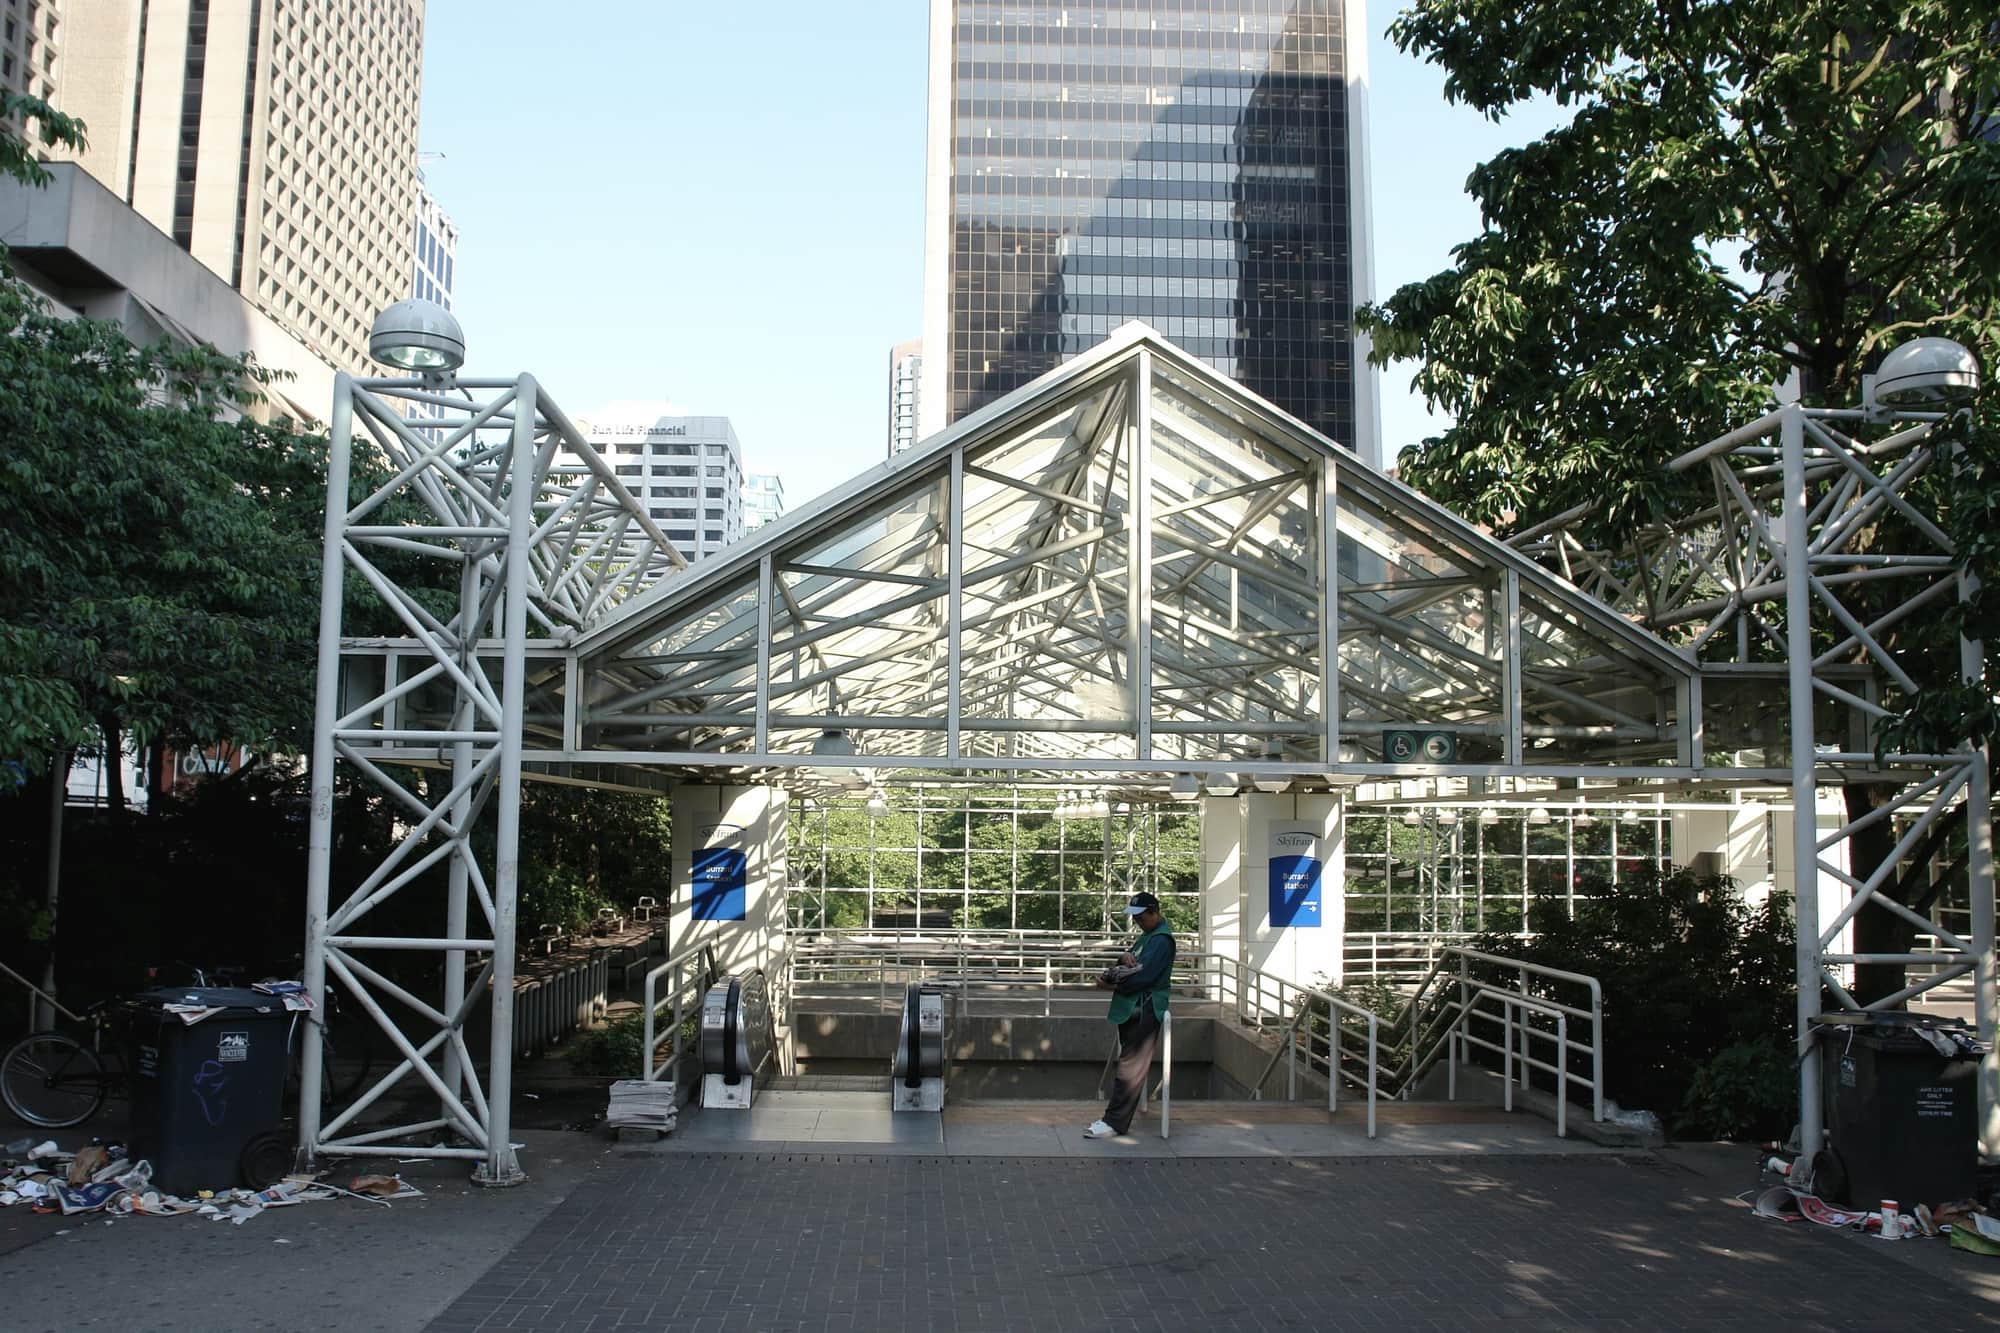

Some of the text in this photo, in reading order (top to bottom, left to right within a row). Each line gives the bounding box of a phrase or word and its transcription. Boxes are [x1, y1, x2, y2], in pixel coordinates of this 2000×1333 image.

[637, 425, 686, 436] Financial
[1277, 835, 1313, 848] SkyTrain
[705, 864, 732, 873] Burrard
[1283, 872, 1309, 881] Burrard
[1283, 882, 1309, 890] Station
